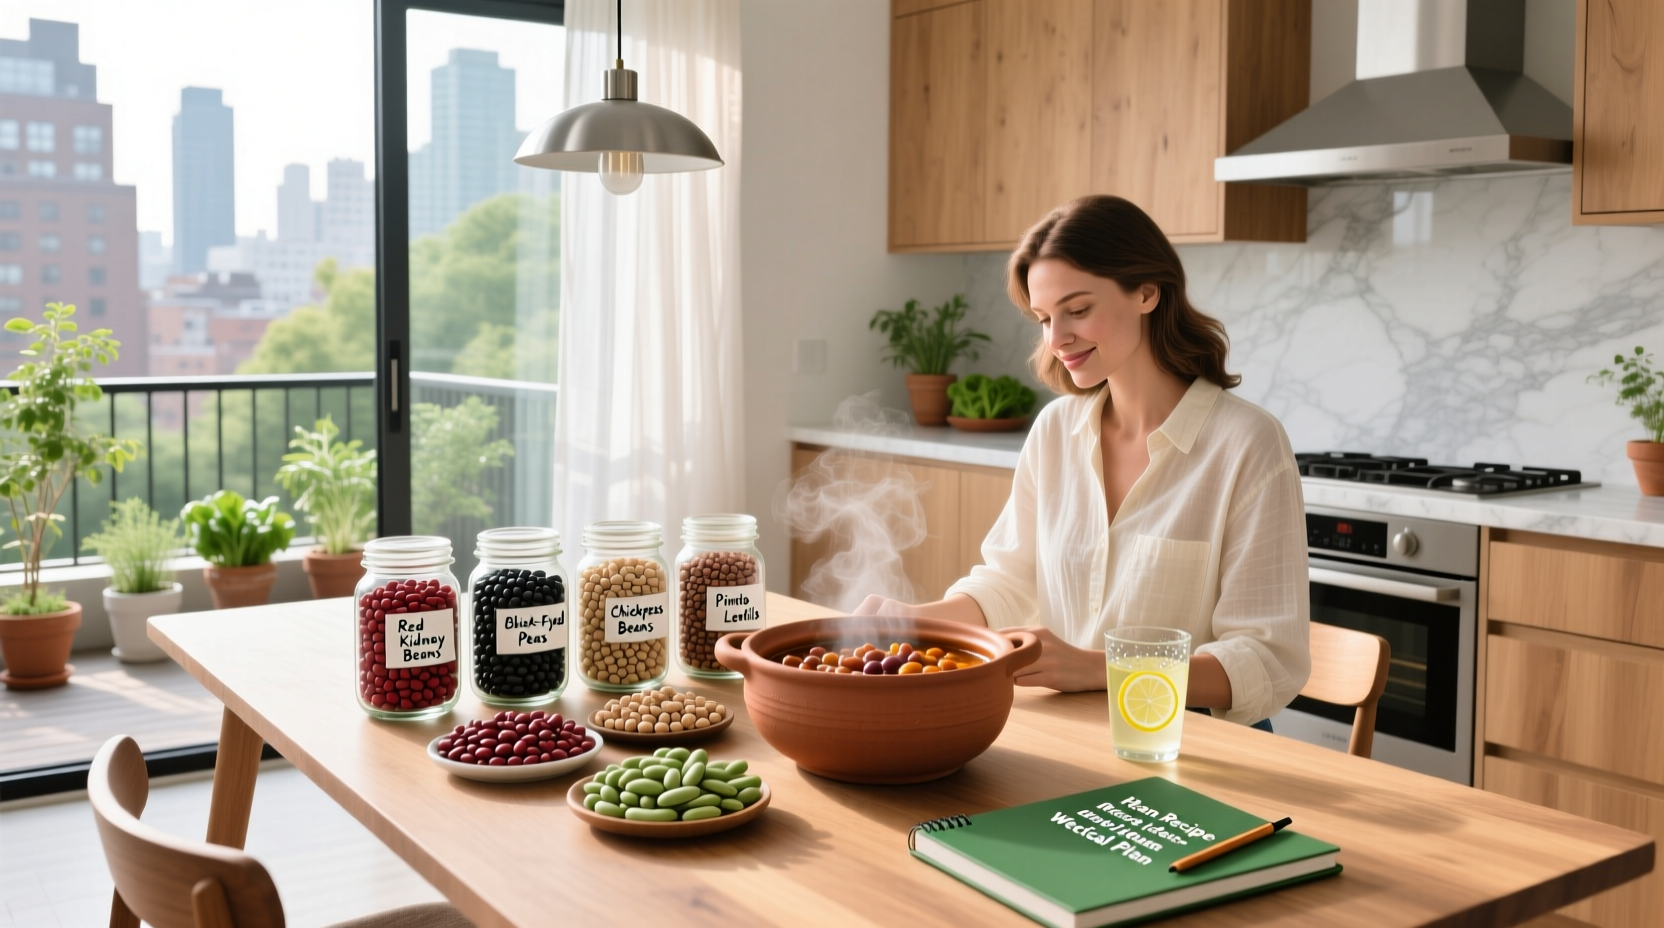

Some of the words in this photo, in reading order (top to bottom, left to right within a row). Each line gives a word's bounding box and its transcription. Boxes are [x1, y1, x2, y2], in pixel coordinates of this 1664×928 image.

[398, 617, 424, 633] Red
[518, 631, 548, 647] Peas
[1158, 812, 1216, 841] Recipe
[1109, 841, 1152, 866] Plan
